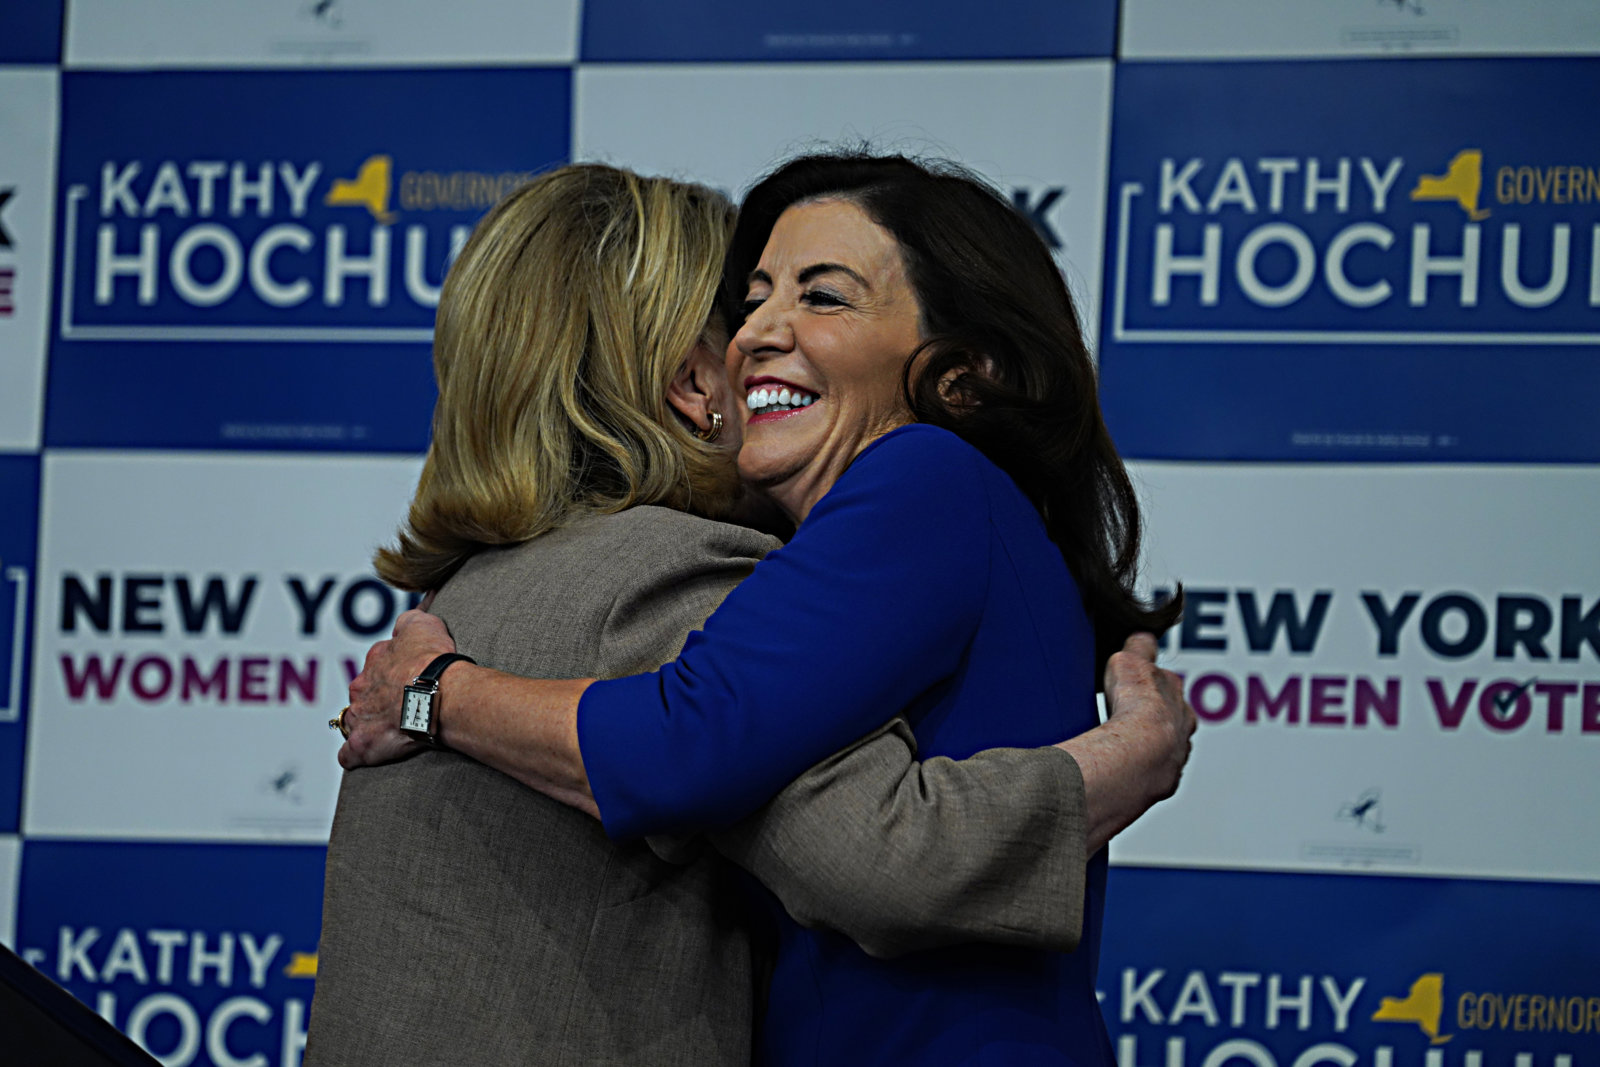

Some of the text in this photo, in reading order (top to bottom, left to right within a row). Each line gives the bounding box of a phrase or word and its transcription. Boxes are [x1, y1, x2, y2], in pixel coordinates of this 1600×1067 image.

[100, 160, 530, 218] KATHY GOVERN
[1158, 157, 1404, 214] KATHY
[94, 223, 472, 308] HOCHU
[1152, 222, 1600, 308] HOCHU
[59, 573, 424, 637] NEW YO
[1153, 588, 1600, 661] EW YORK
[59, 653, 320, 704] WOMEN
[1178, 671, 1402, 727] OMEN
[57, 925, 284, 988] KATHY
[1120, 968, 1600, 1034] KATHY GOVERNOR
